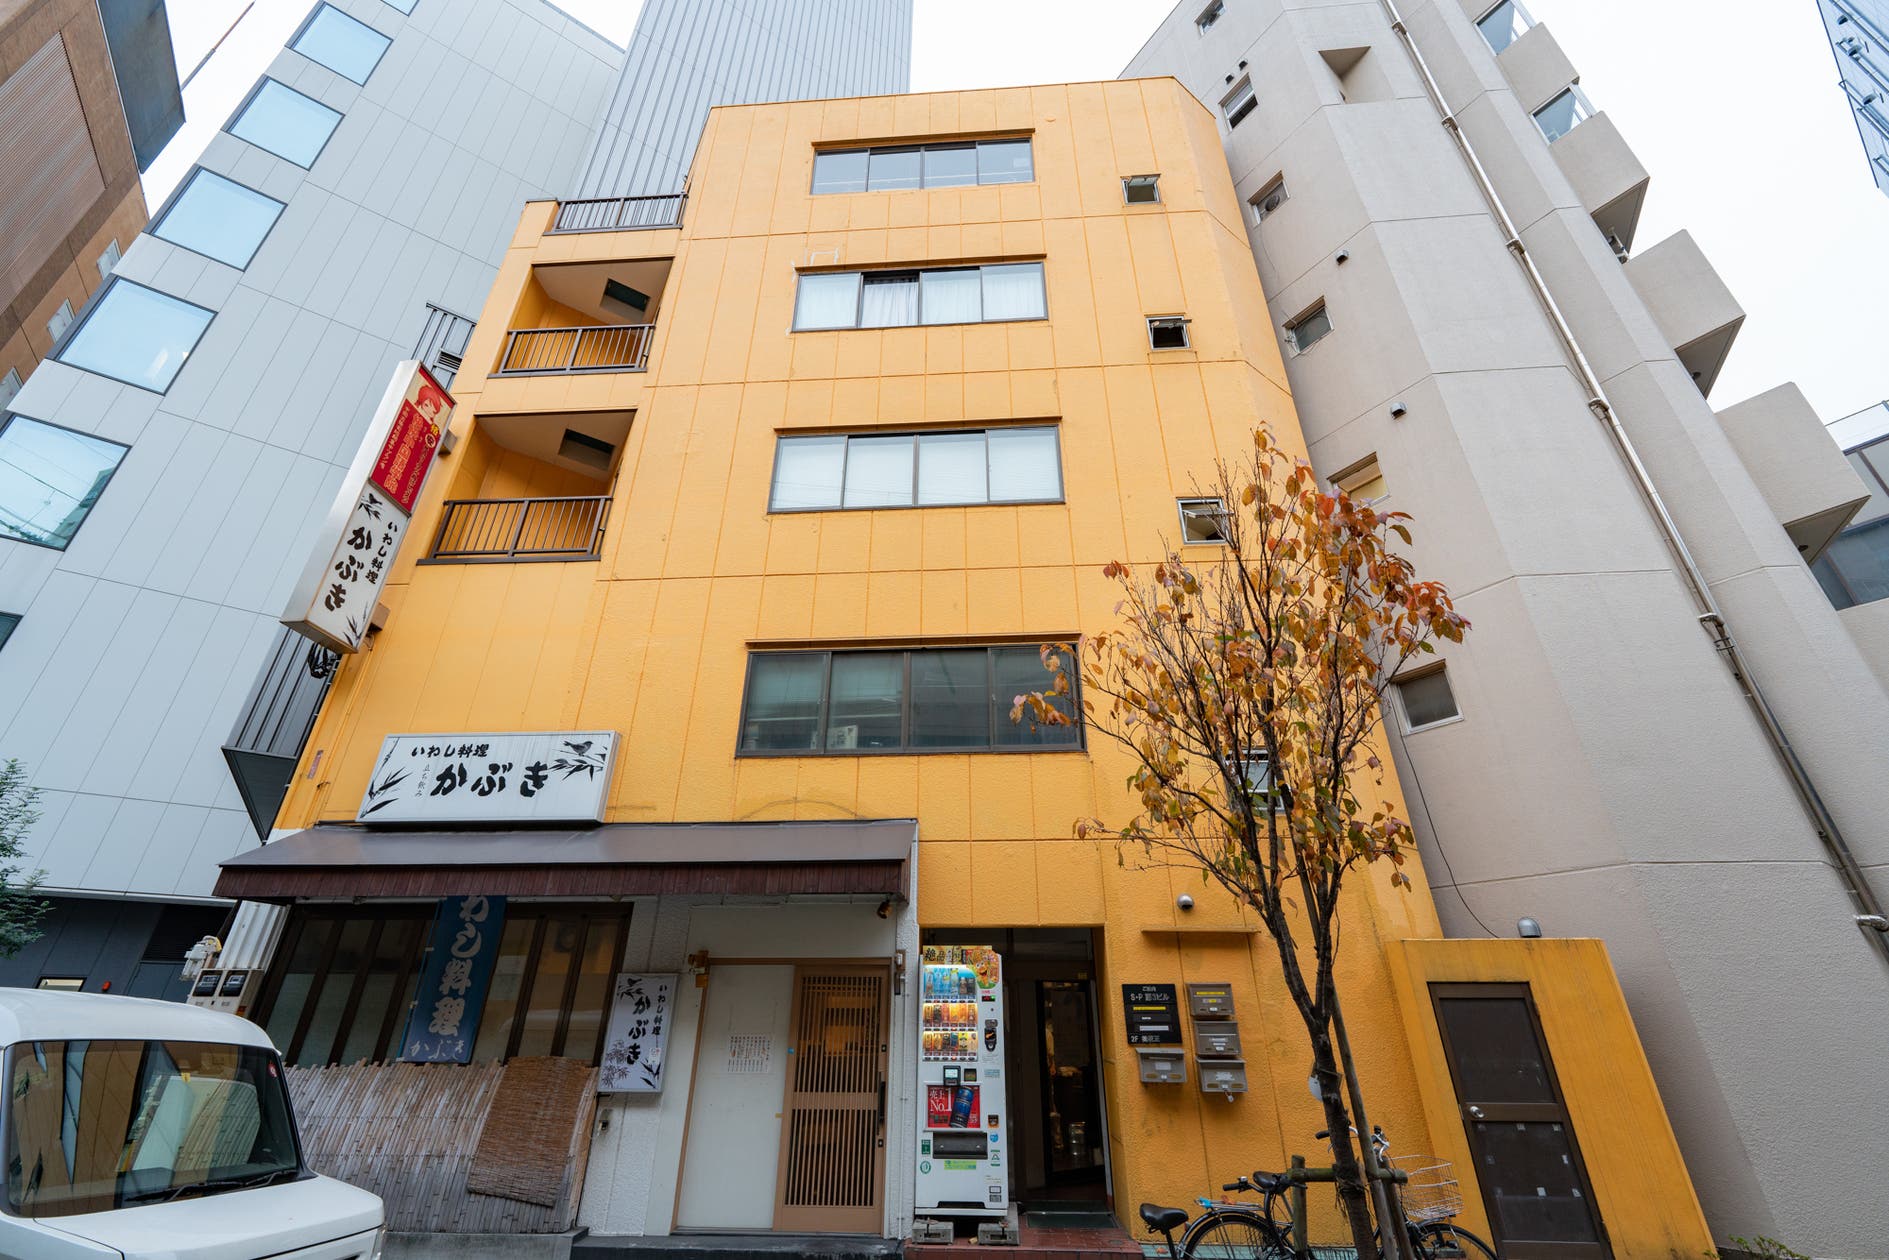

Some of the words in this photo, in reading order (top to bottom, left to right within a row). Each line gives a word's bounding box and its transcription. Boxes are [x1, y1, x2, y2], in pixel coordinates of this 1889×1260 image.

[325, 527, 373, 612] かぶき
[365, 521, 398, 585] いわし料理
[411, 744, 490, 758] いわし料理
[430, 761, 549, 798] かぶき
[628, 996, 651, 1065] かぶき
[651, 984, 668, 1036] いわし料理
[409, 1038, 466, 1060] かぶき
[930, 1089, 945, 1100] 売上
